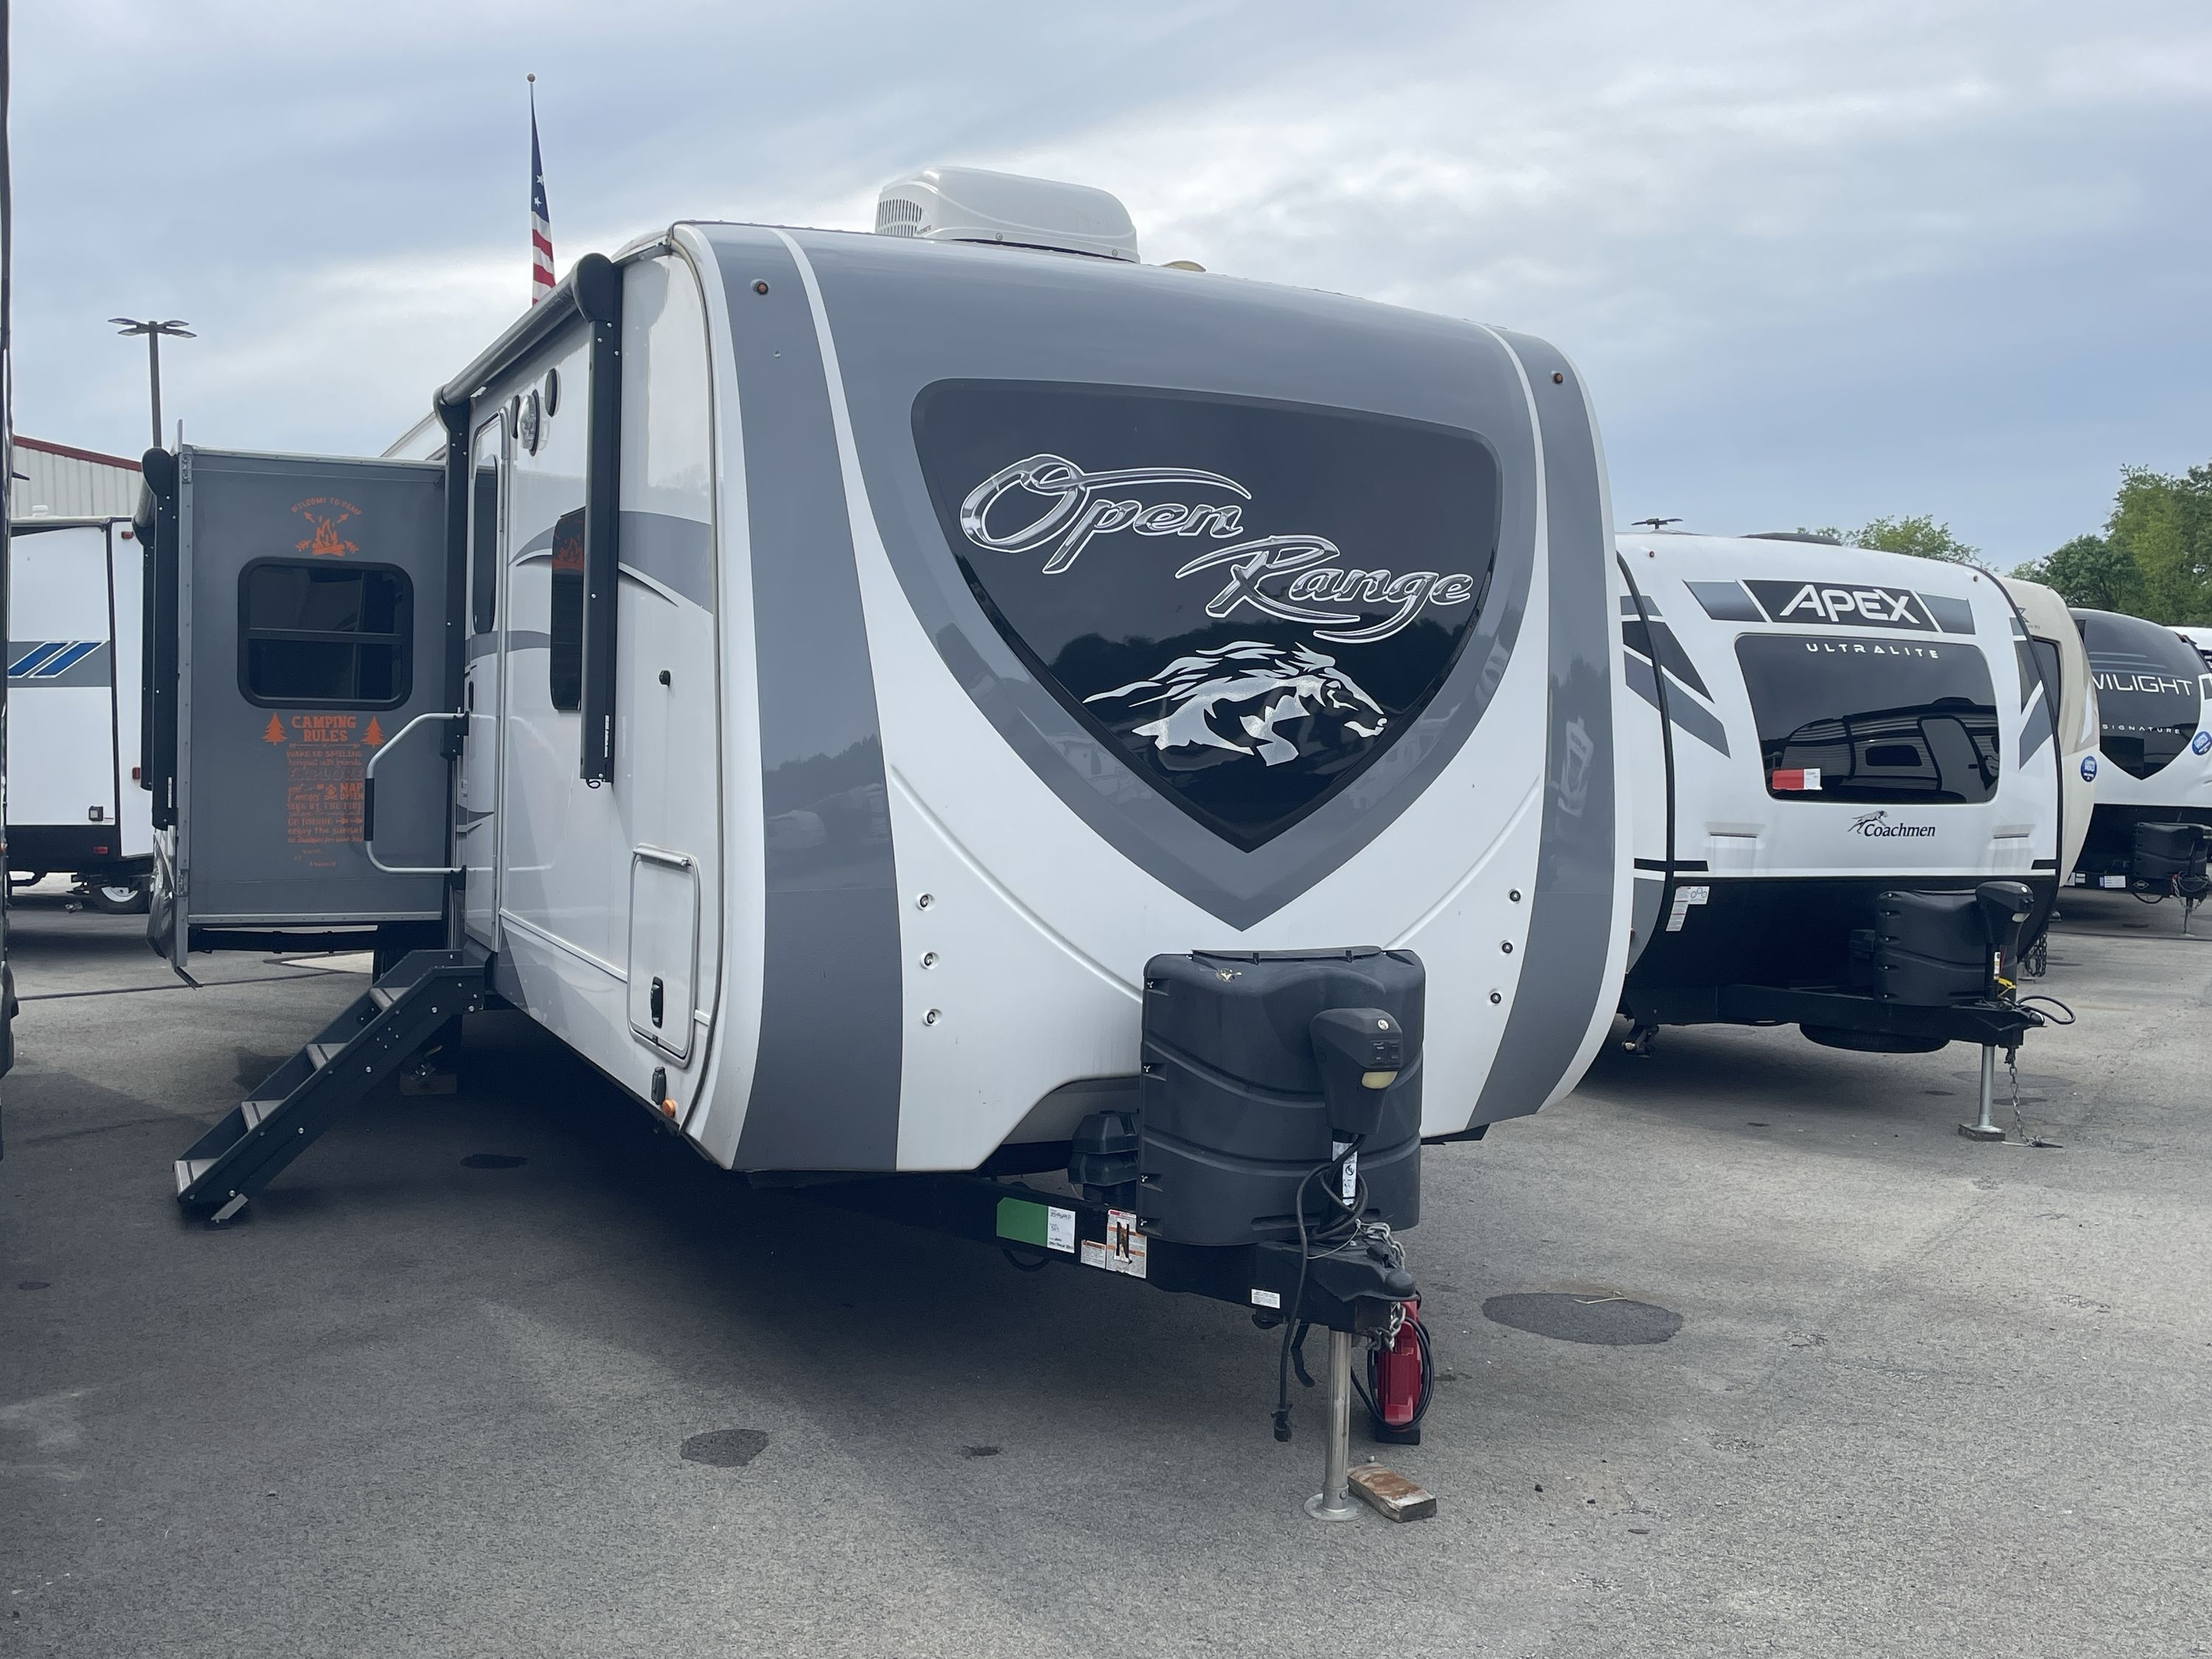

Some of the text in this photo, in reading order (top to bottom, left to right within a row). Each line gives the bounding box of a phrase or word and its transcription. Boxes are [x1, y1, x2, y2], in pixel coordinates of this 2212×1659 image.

[961, 453, 1251, 574] Open
[1175, 535, 1473, 643] Range
[1778, 584, 1920, 624] APEX
[1806, 643, 1940, 659] ULTRALITE
[291, 715, 356, 729] CAMPING
[2102, 723, 2181, 735] SIGNATURE
[303, 729, 349, 742] RULES
[339, 782, 364, 793] NAP
[1864, 823, 1935, 837] Coachmen
